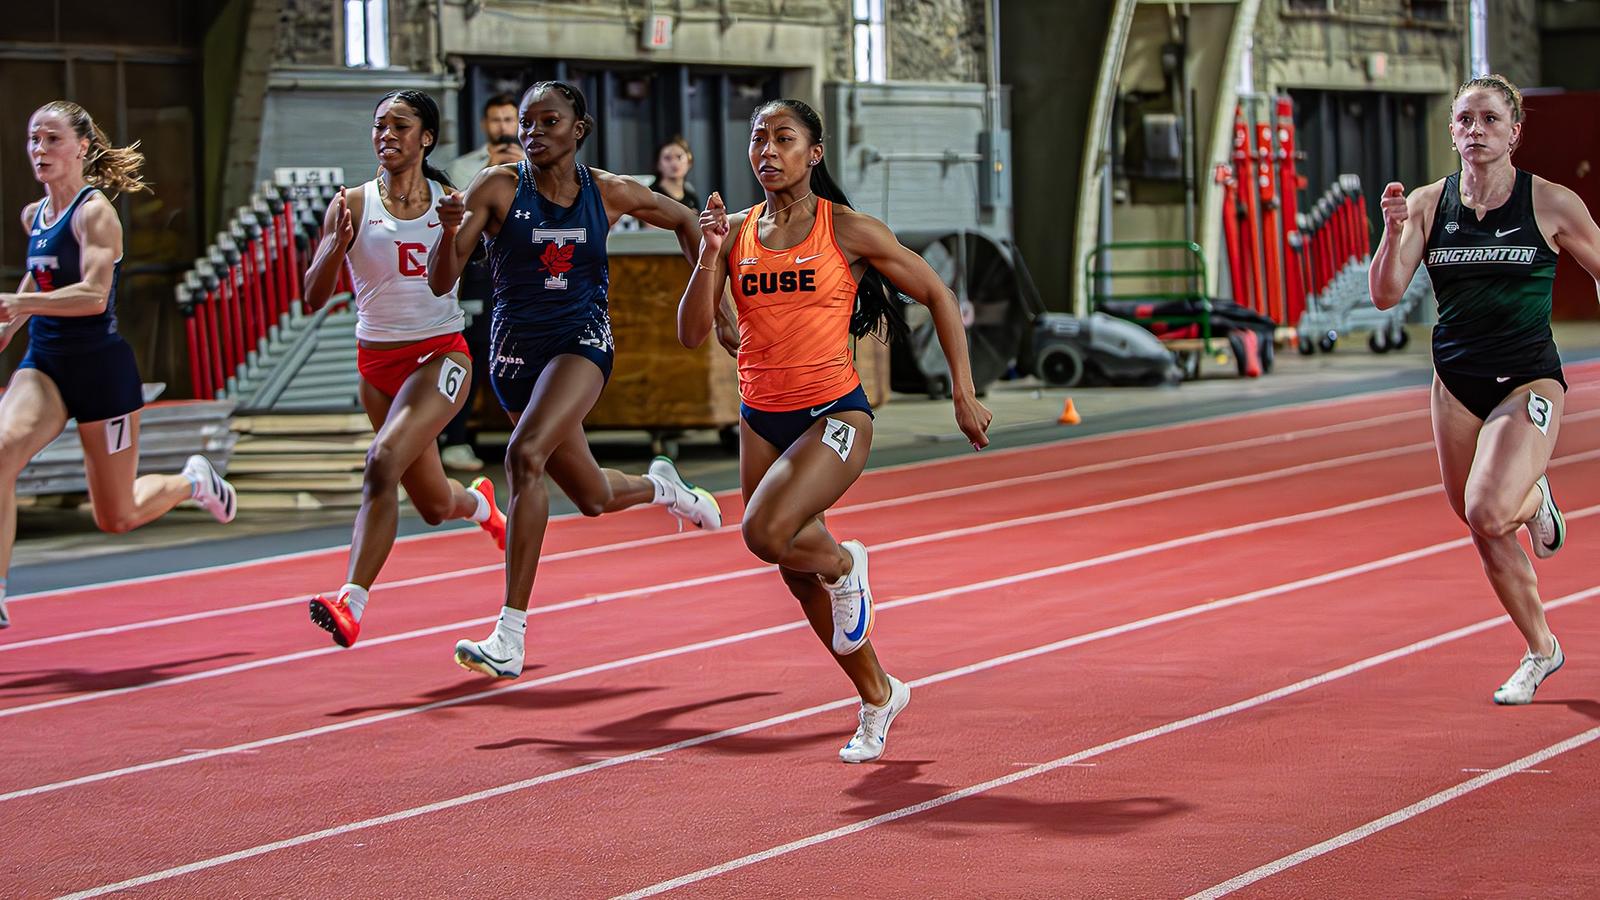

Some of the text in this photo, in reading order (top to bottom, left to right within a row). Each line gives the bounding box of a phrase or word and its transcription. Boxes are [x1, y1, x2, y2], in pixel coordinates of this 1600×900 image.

[398, 242, 427, 277] C
[532, 228, 586, 290] T
[739, 257, 759, 265] ACC
[1428, 248, 1533, 264] BINGHAMTON
[446, 367, 461, 397] 6
[1532, 396, 1549, 427] 3
[111, 416, 125, 450] 7
[831, 423, 849, 454] 4
